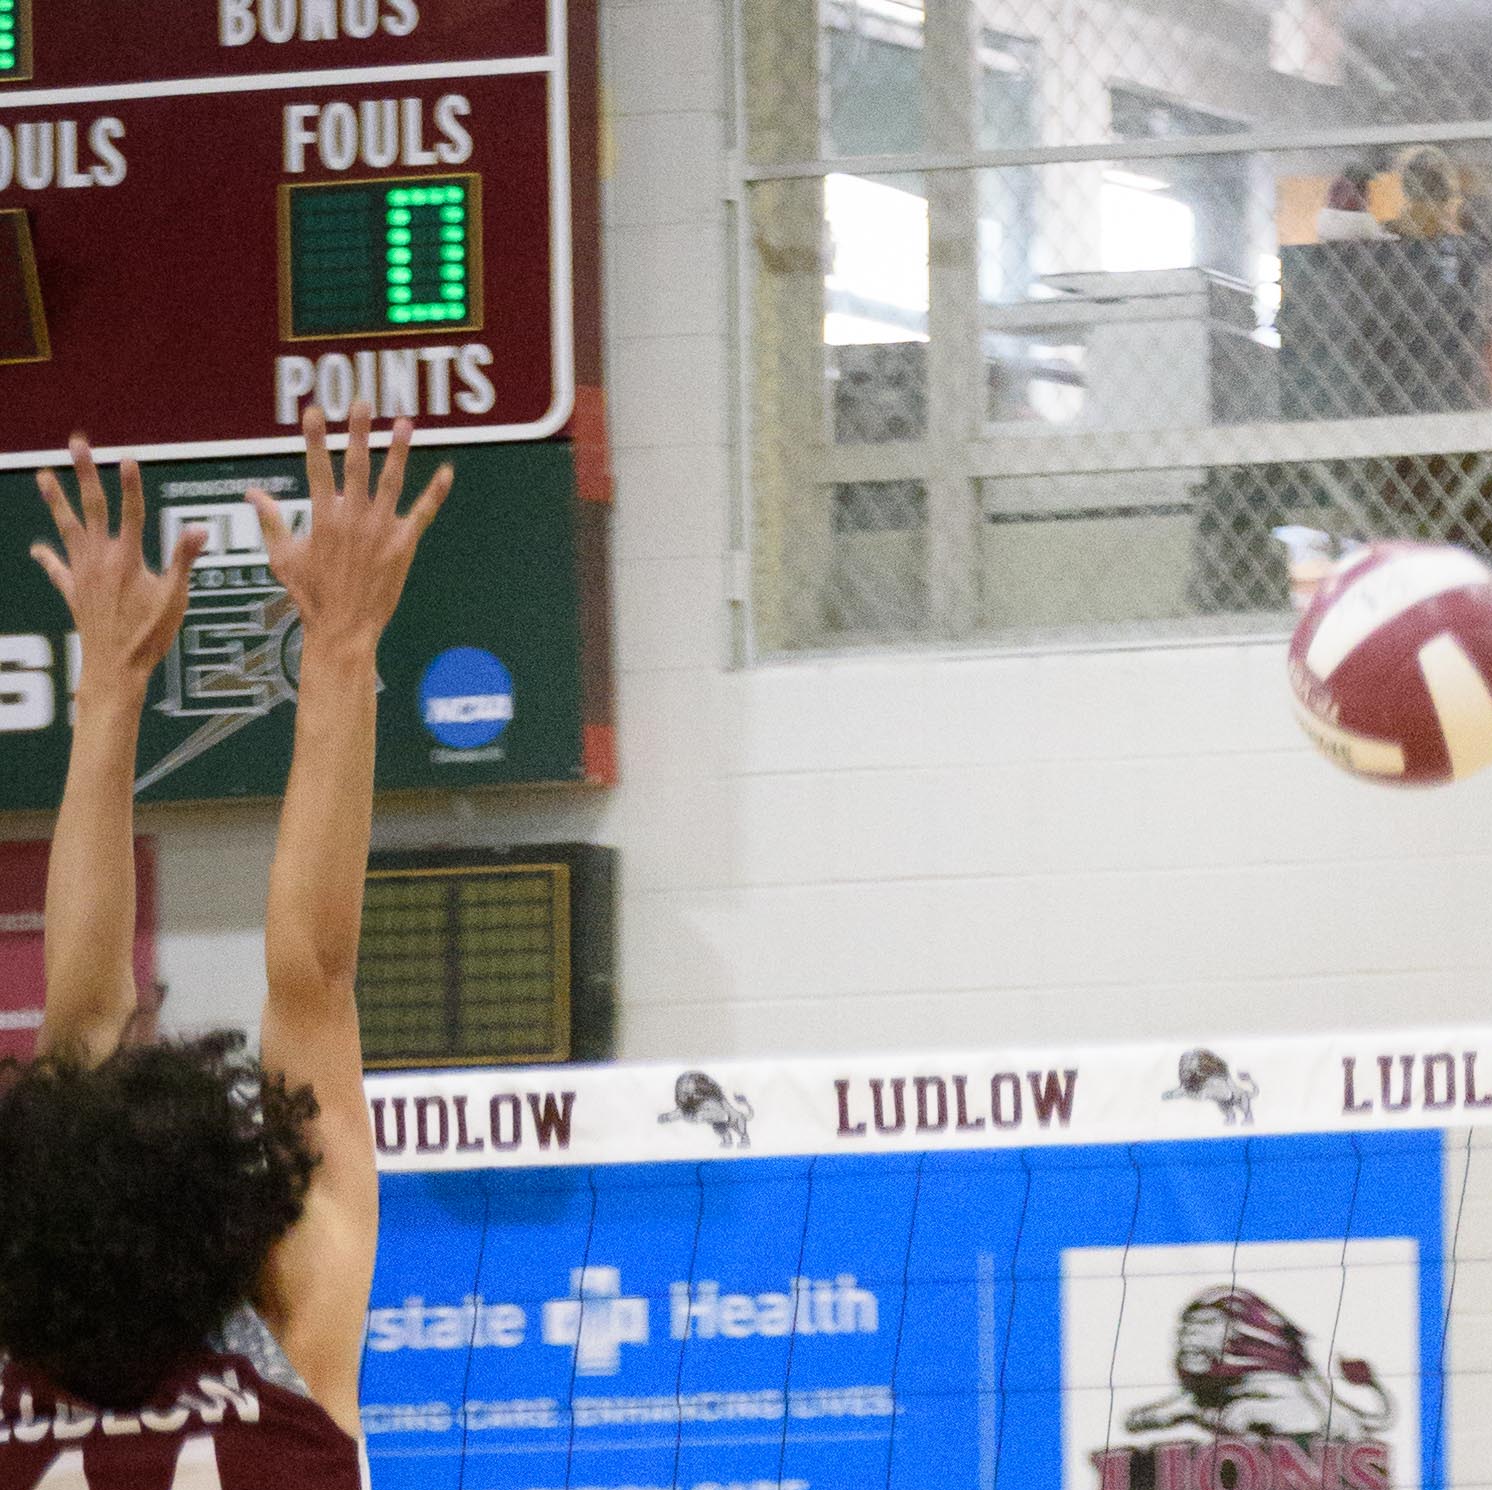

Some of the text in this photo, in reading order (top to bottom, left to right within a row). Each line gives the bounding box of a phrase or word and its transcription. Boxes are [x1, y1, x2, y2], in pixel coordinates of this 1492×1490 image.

[282, 95, 472, 172] FOULS
[275, 343, 496, 424] POINTS
[371, 1090, 576, 1155] UDLOW
[834, 1069, 1078, 1137] LUDLOW
[670, 1273, 880, 1340] Health
